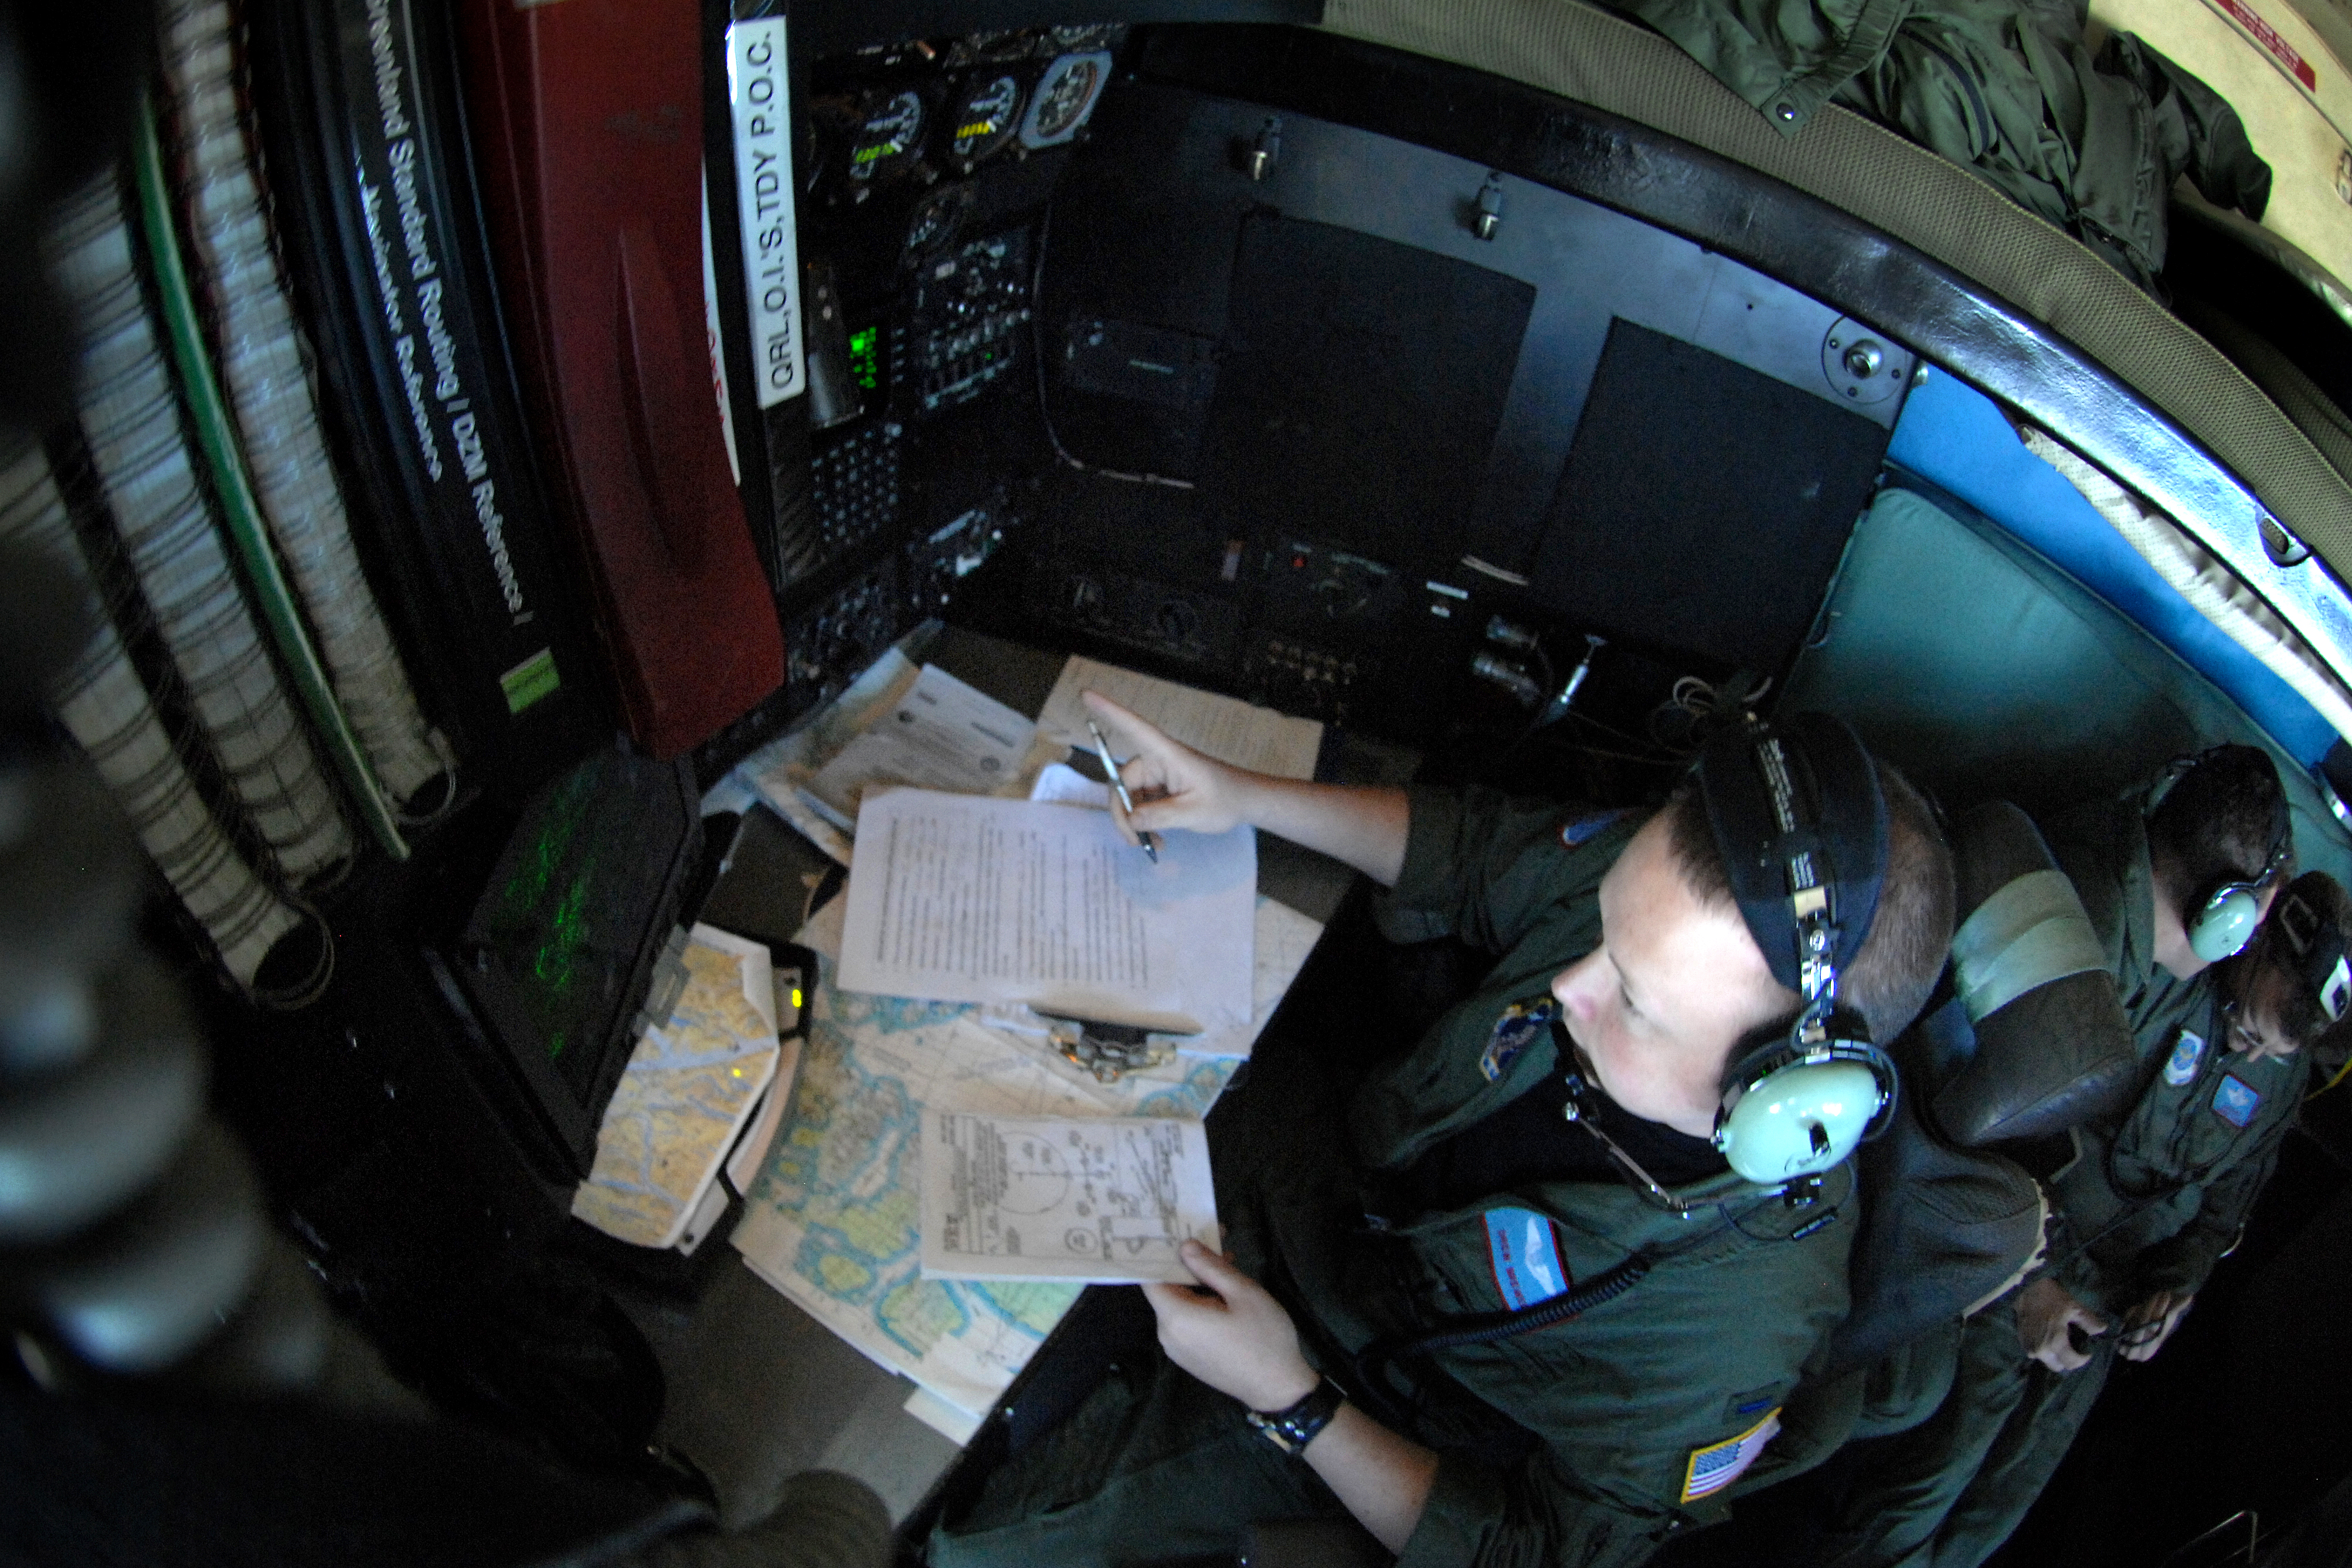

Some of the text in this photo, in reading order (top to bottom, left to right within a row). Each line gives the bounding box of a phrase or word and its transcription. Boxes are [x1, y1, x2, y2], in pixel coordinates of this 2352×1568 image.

[746, 30, 776, 138] P.O.C.
[389, 138, 437, 281] Standard
[417, 277, 460, 401] Routing
[453, 411, 488, 483] DZM
[471, 478, 524, 614] Reference
[395, 334, 443, 483] Reference
